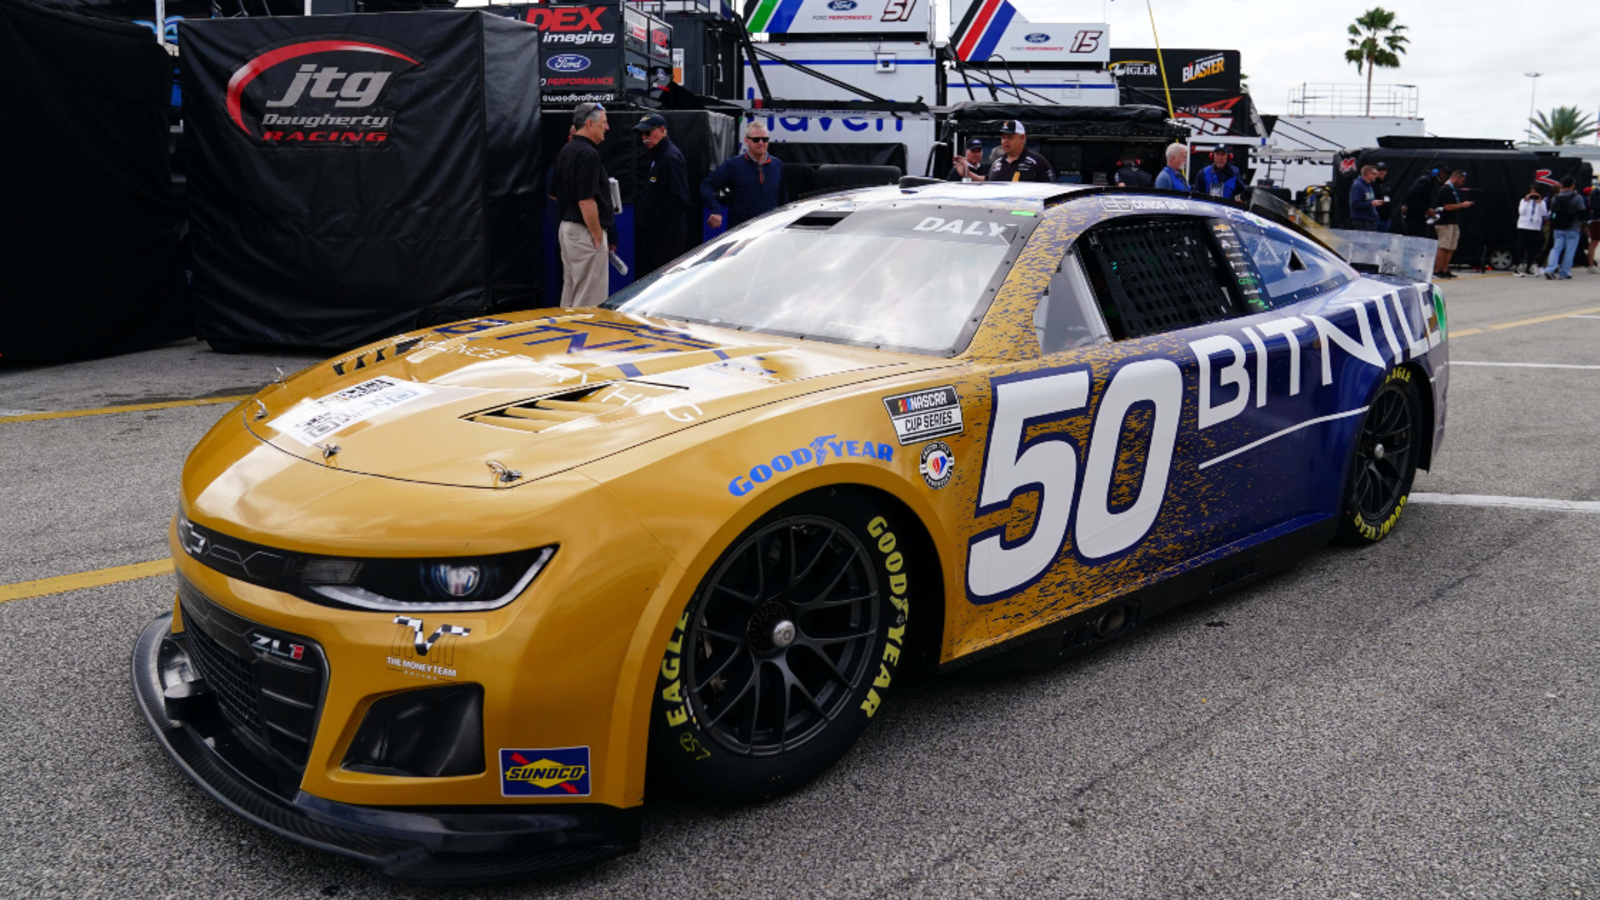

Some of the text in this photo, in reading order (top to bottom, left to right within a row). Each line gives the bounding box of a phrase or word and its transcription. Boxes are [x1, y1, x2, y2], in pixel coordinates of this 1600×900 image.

[525, 6, 608, 31] DEX
[880, 0, 917, 22] 51
[542, 31, 615, 45] imaging
[1029, 34, 1046, 43] Ford
[1069, 30, 1104, 53] 15
[554, 56, 583, 69] Ford
[265, 64, 393, 108] jtg
[547, 77, 615, 86] PERFORMANCE
[261, 113, 390, 129] Daugherty
[261, 131, 388, 143] RACING
[1131, 200, 1166, 210] CONOR
[1165, 200, 1189, 211] DALY
[912, 216, 1018, 238] DALY
[1188, 282, 1442, 428] BITNILE
[1386, 366, 1412, 383] EAGLE
[909, 391, 948, 411] NASCAR
[904, 411, 953, 433] CUP SERIES
[967, 358, 1183, 597] 50
[860, 516, 909, 718] GOODYEAR
[252, 633, 304, 660] ZL1
[386, 656, 457, 677] THE MONEY TEAM
[662, 611, 689, 727] EAGLE
[508, 766, 584, 780] SUNOCO
